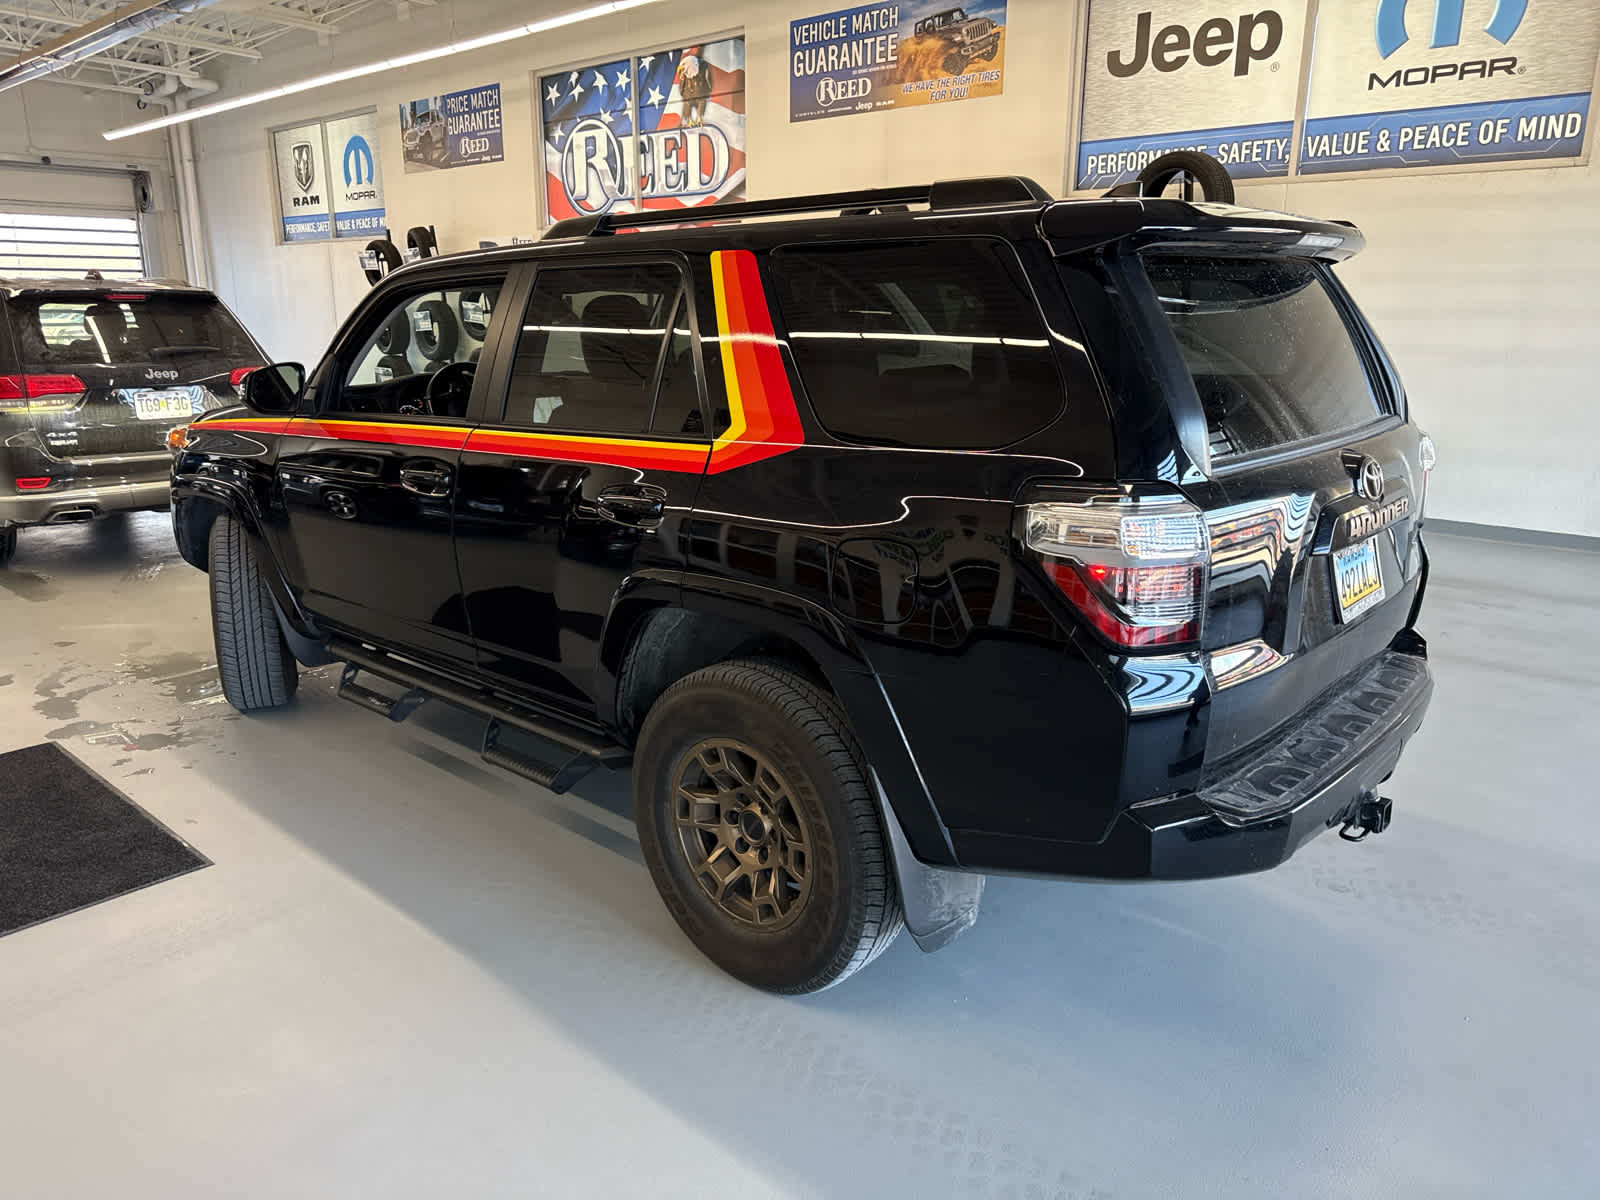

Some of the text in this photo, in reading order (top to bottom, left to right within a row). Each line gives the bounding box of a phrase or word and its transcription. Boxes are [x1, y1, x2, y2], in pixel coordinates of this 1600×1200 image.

[793, 6, 899, 46] VEHICLE MATCH
[793, 32, 898, 78] GUARANTEE
[1107, 10, 1283, 77] Jeep
[902, 70, 1000, 94] WE HAVE THE RIGHT TIRES
[1368, 56, 1518, 90] MOPAR
[447, 88, 499, 115] PRICE MATCH
[816, 77, 872, 106] REED
[930, 86, 968, 102] FOR YOU!
[855, 101, 873, 112] Jeep
[447, 108, 500, 136] GUARANTEE
[460, 137, 489, 157] REED
[1216, 138, 1290, 164] SAFETY,
[1307, 130, 1371, 158] VALUE
[1376, 129, 1391, 152] &
[1398, 121, 1472, 151] PEACE
[1478, 118, 1512, 145] OF
[1517, 112, 1582, 142] MIND
[565, 122, 730, 205] REED
[293, 195, 320, 207] RAM
[345, 190, 377, 201] MOPAR
[357, 217, 371, 229] PEACE
[372, 216, 378, 228] OF
[145, 368, 179, 380] Jeep
